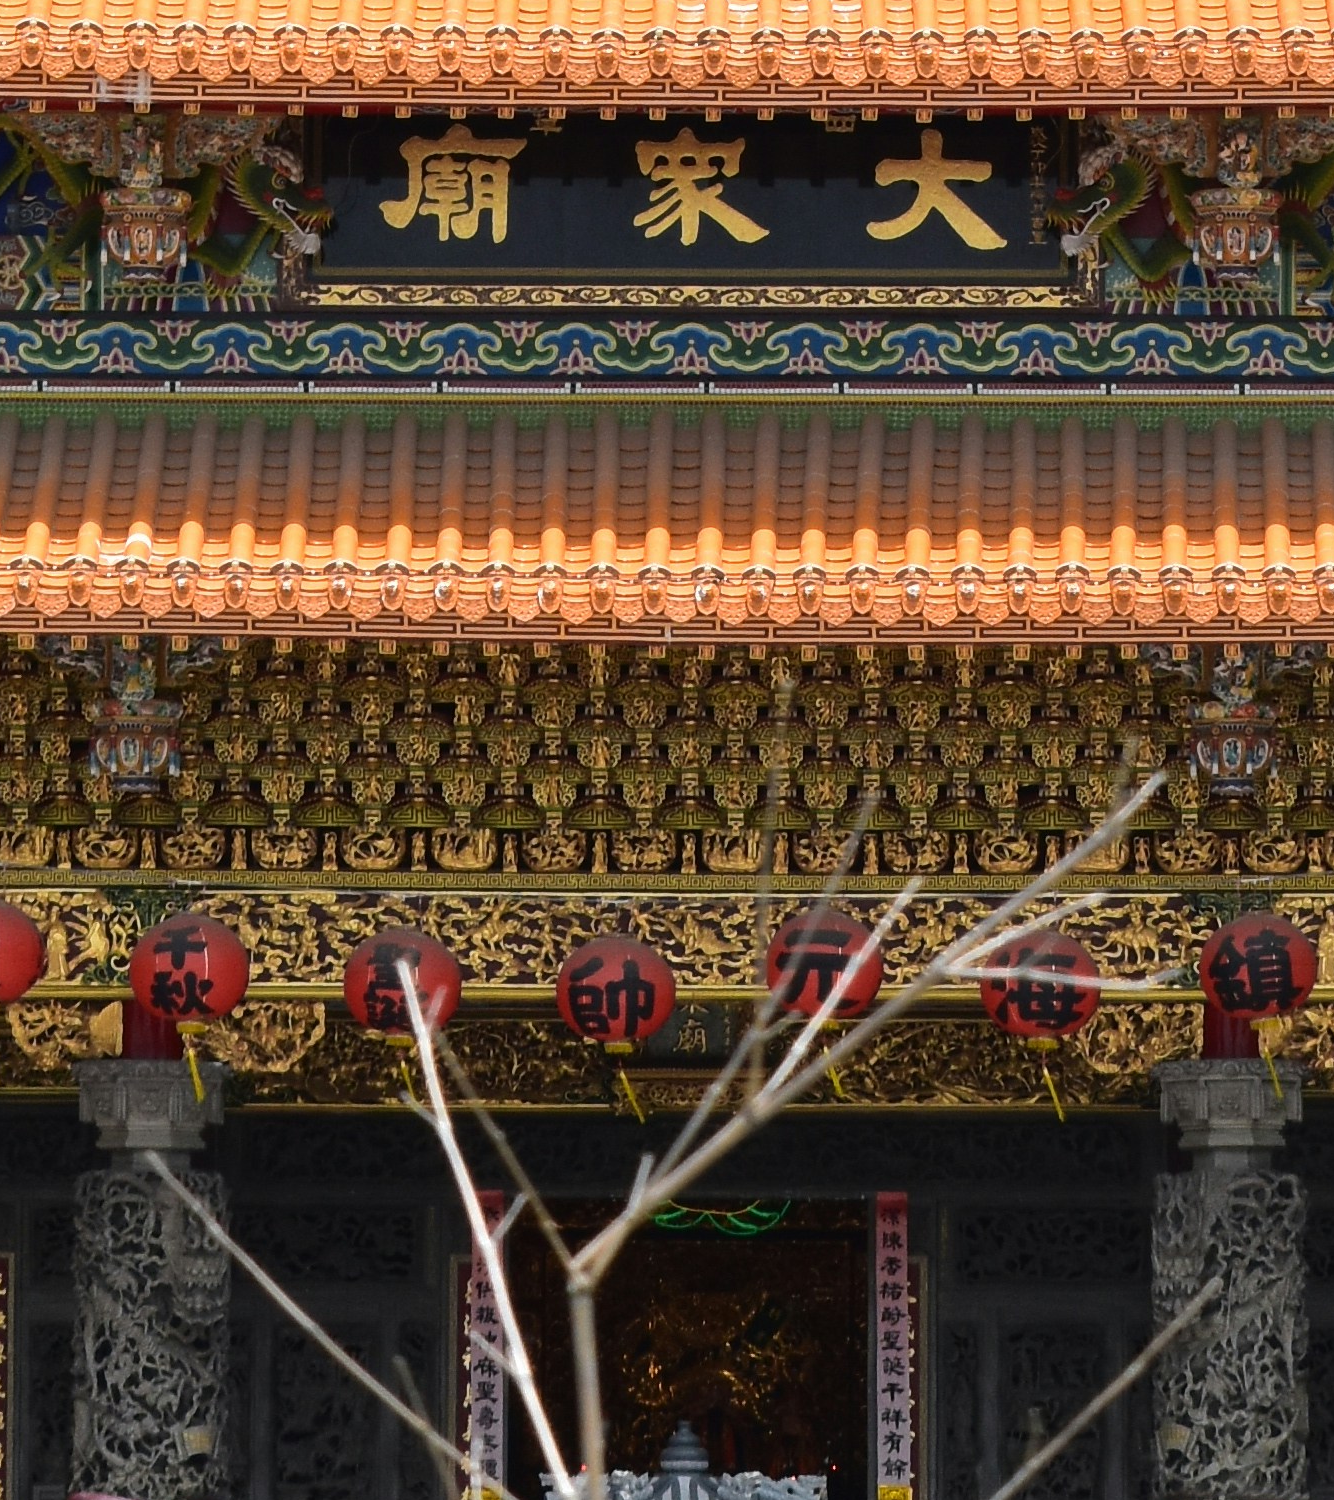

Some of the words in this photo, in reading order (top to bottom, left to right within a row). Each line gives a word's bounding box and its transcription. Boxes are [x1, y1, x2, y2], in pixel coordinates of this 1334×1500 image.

[150, 926, 215, 1015] 千秋
[568, 956, 658, 1037] 帥
[775, 928, 863, 1009] 元
[987, 947, 1085, 1026] 海
[1210, 930, 1304, 1012] 鎮
